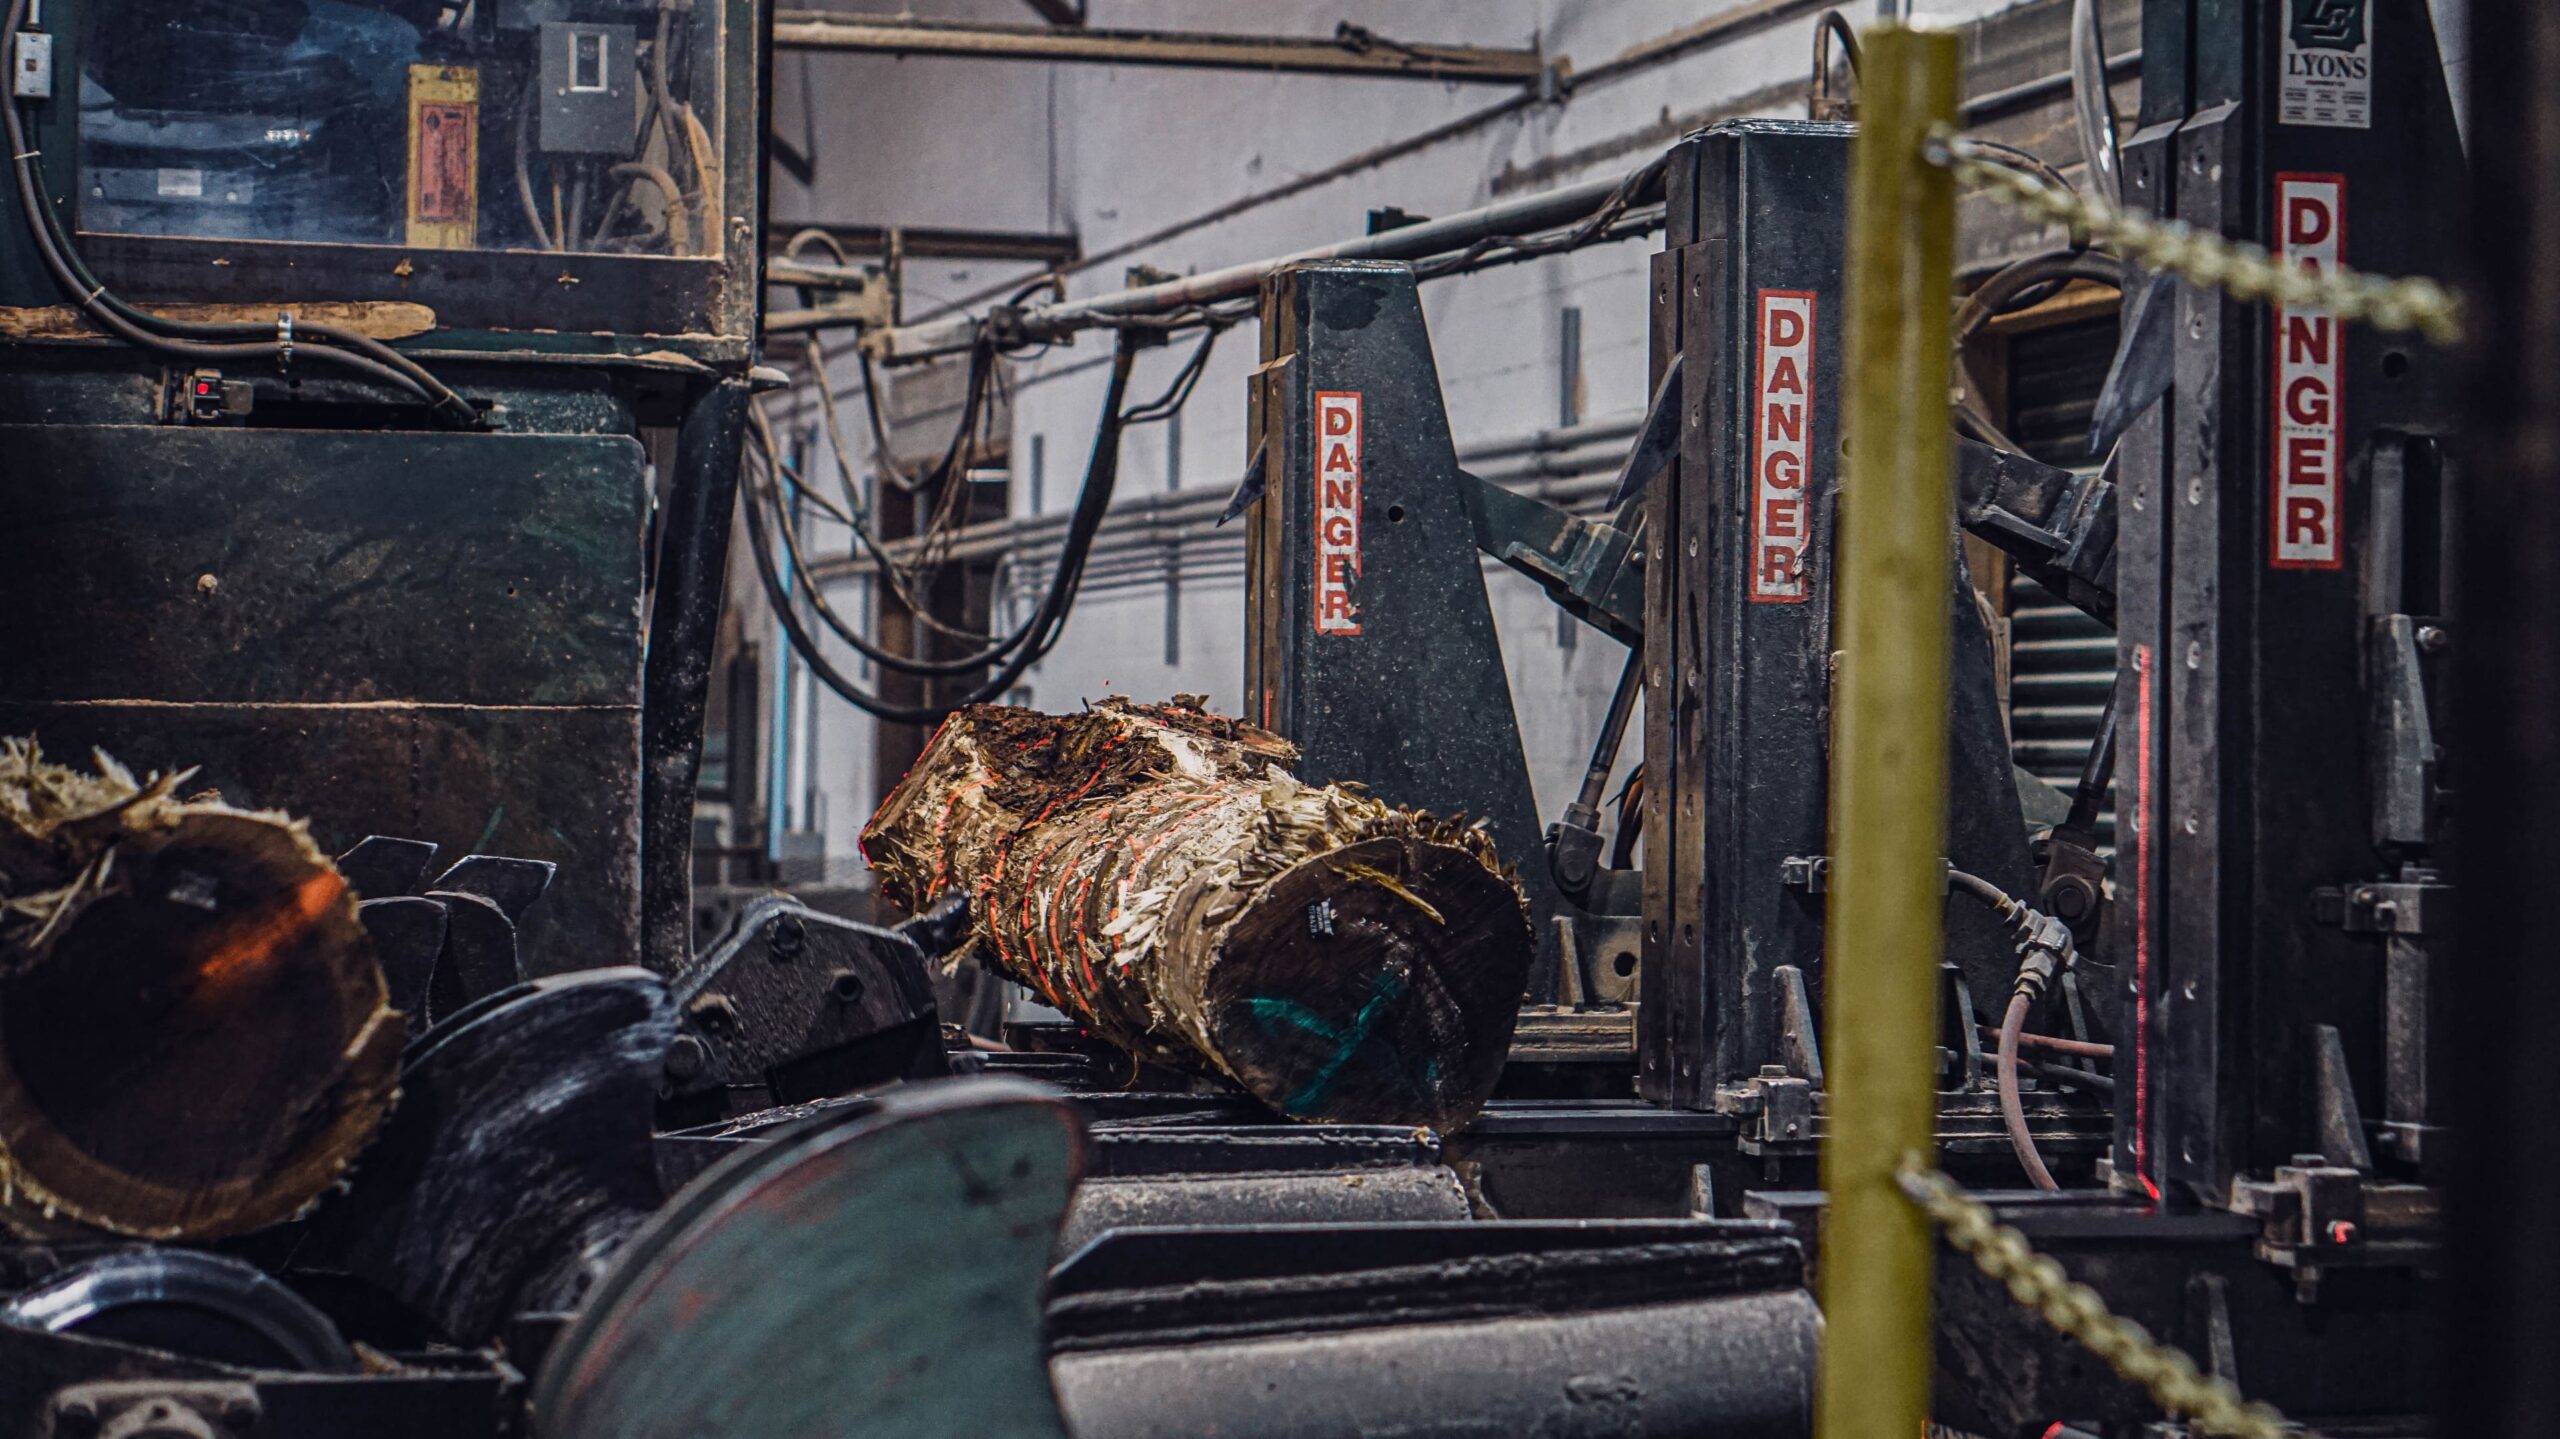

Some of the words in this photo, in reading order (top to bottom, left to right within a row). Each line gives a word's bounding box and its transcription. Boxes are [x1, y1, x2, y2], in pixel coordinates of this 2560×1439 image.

[2287, 53, 2367, 80] LYONS
[1324, 406, 1353, 620] DANGER
[1764, 308, 1805, 584] DANGER
